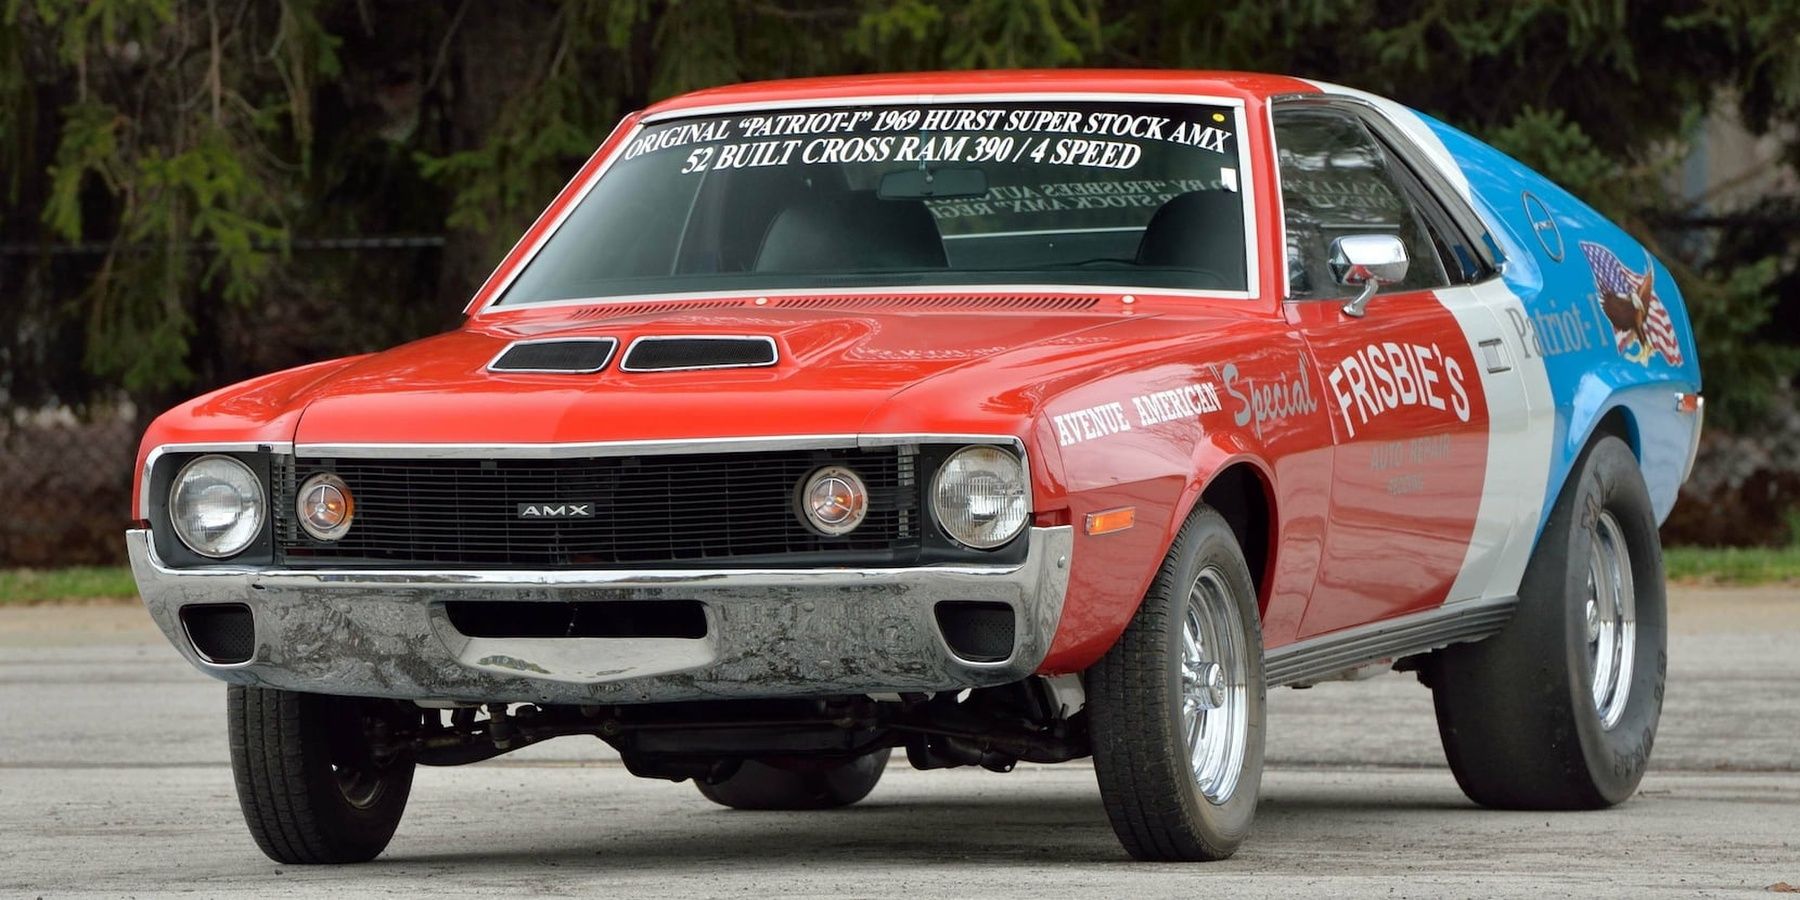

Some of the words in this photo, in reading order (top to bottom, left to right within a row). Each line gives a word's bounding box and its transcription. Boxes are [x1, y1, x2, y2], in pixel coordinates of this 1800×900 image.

[624, 119, 730, 160] ORIGINAL
[738, 111, 873, 137] “PATRIOT-I”
[871, 110, 921, 131] 1969
[919, 109, 1006, 131] HURST
[1004, 110, 1079, 133] SUPER
[1083, 112, 1171, 140] STOCK
[1168, 121, 1232, 153] AMX
[681, 147, 713, 174] 52
[713, 140, 801, 170] BUILT
[802, 137, 895, 164] CROSS
[893, 136, 970, 161] RAM
[966, 136, 1014, 162] 390
[1030, 137, 1051, 163] 4
[1049, 138, 1142, 169] SPEED
[1054, 402, 1131, 446] AVENUE
[1132, 382, 1222, 427] AMERICAN
[1329, 342, 1470, 438] FRISBIE'S
[522, 505, 589, 516] AMX
